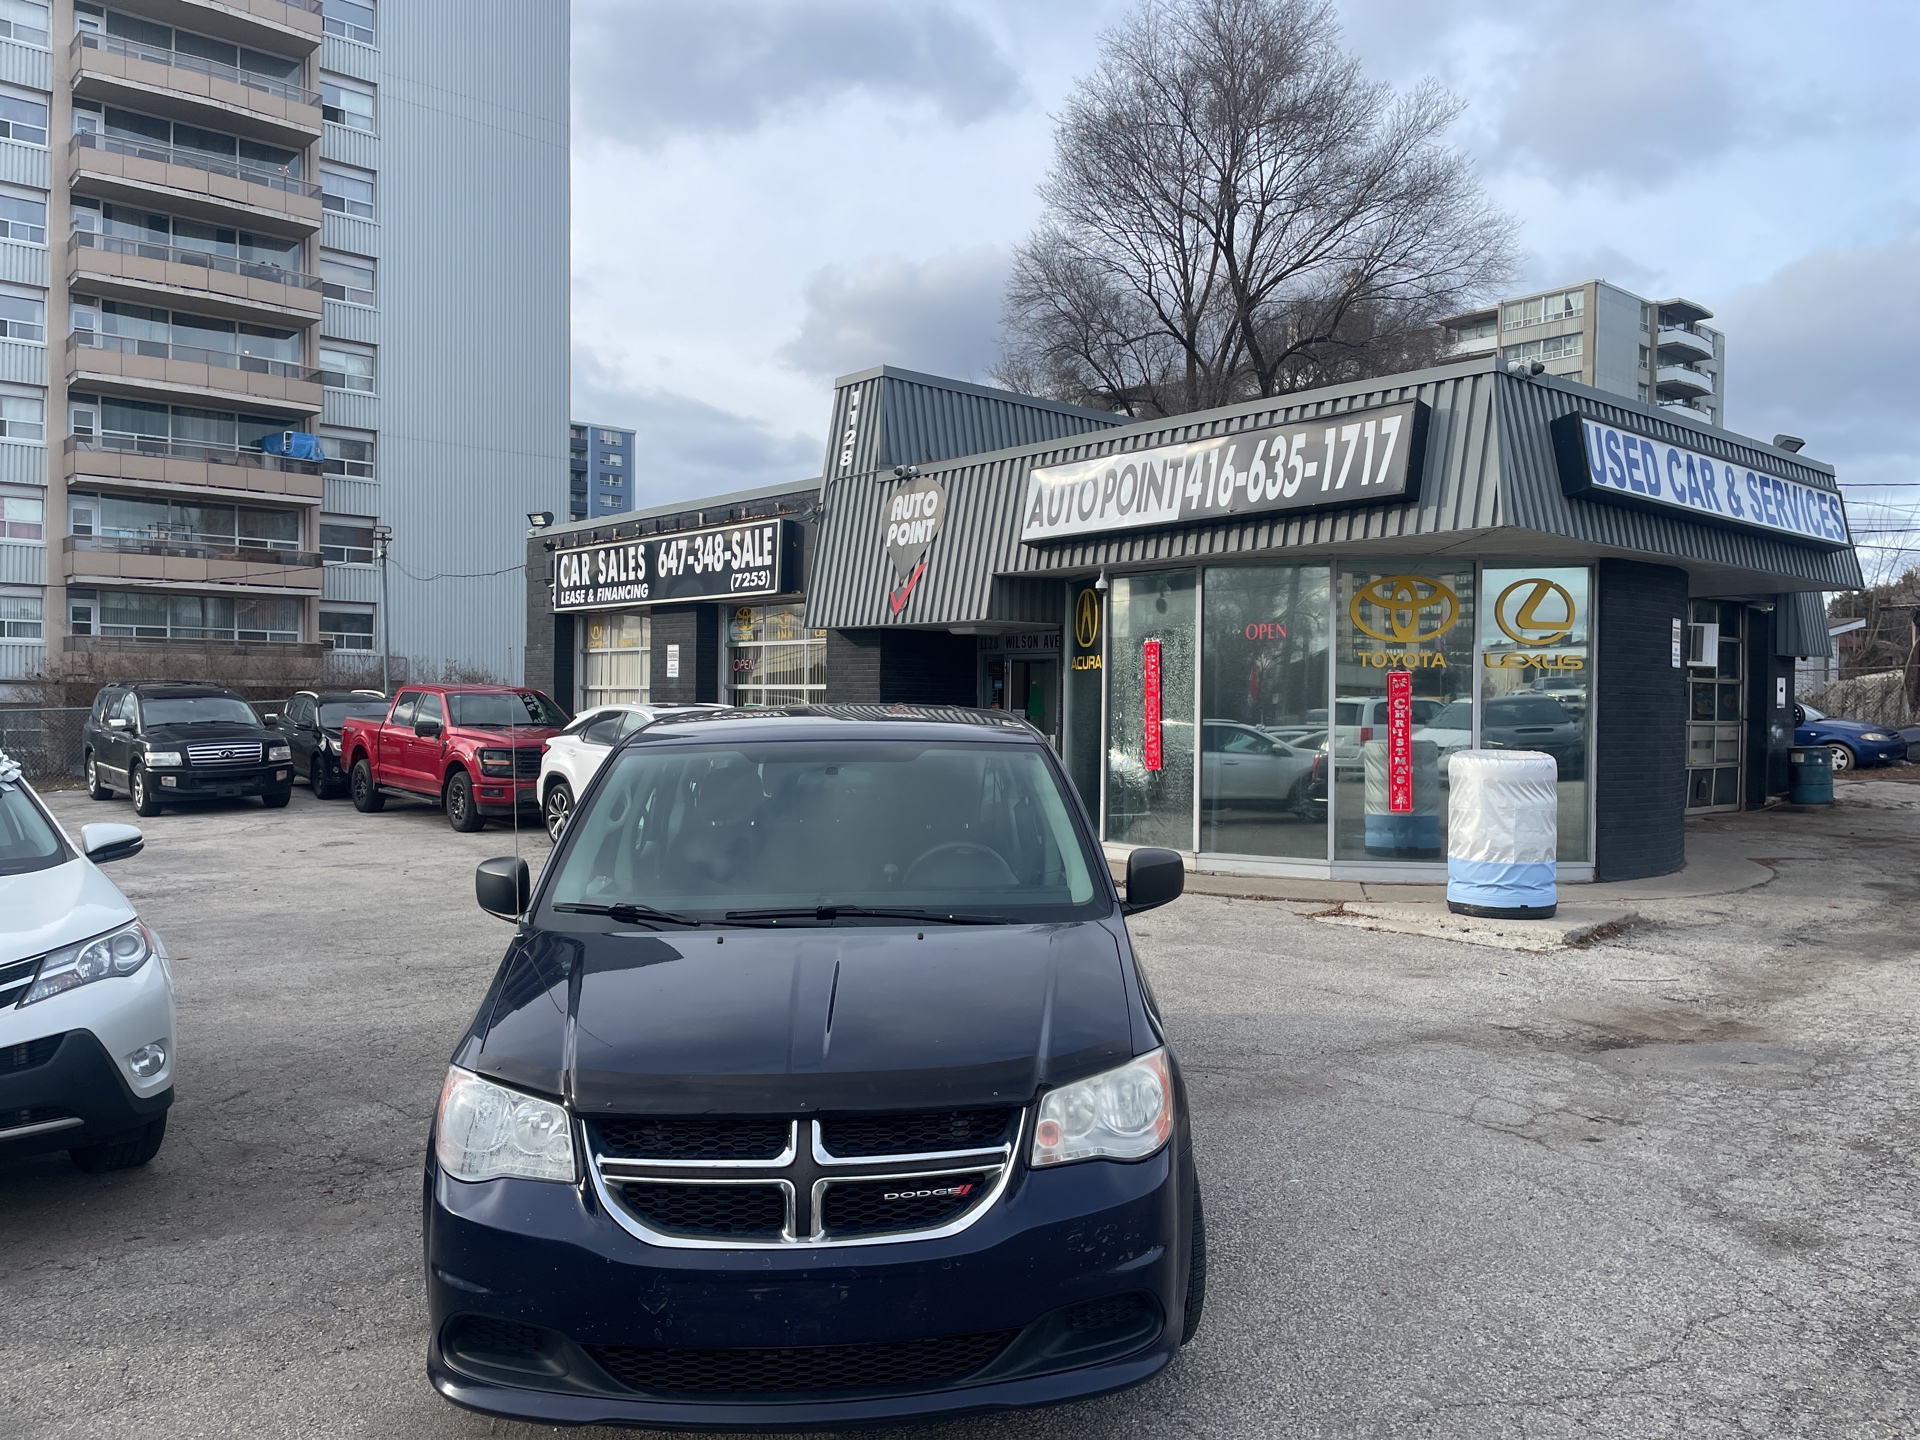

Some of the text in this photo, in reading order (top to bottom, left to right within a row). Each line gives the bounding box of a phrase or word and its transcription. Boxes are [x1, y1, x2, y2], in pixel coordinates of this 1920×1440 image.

[839, 391, 861, 467] 1128
[1185, 415, 1402, 510] 416-635-1717
[1583, 423, 1845, 542] USED CAR & SERVICES
[890, 490, 939, 521] AUTO
[886, 520, 936, 547] POINT
[560, 526, 773, 588] CAR SALES 647-348-SALE
[730, 569, 770, 592] (7253)
[560, 583, 649, 605] LEASE & FINANCING
[980, 634, 1060, 650] 1128 WILSON AVE
[1245, 623, 1288, 640] OPEN
[732, 658, 754, 671] OPEN
[1071, 655, 1103, 670] ACURA
[1357, 652, 1447, 668] TOYOTA
[1483, 653, 1584, 669] LEXUS
[1393, 698, 1407, 784] CHRISTMAS
[884, 1187, 962, 1200] DODGE
